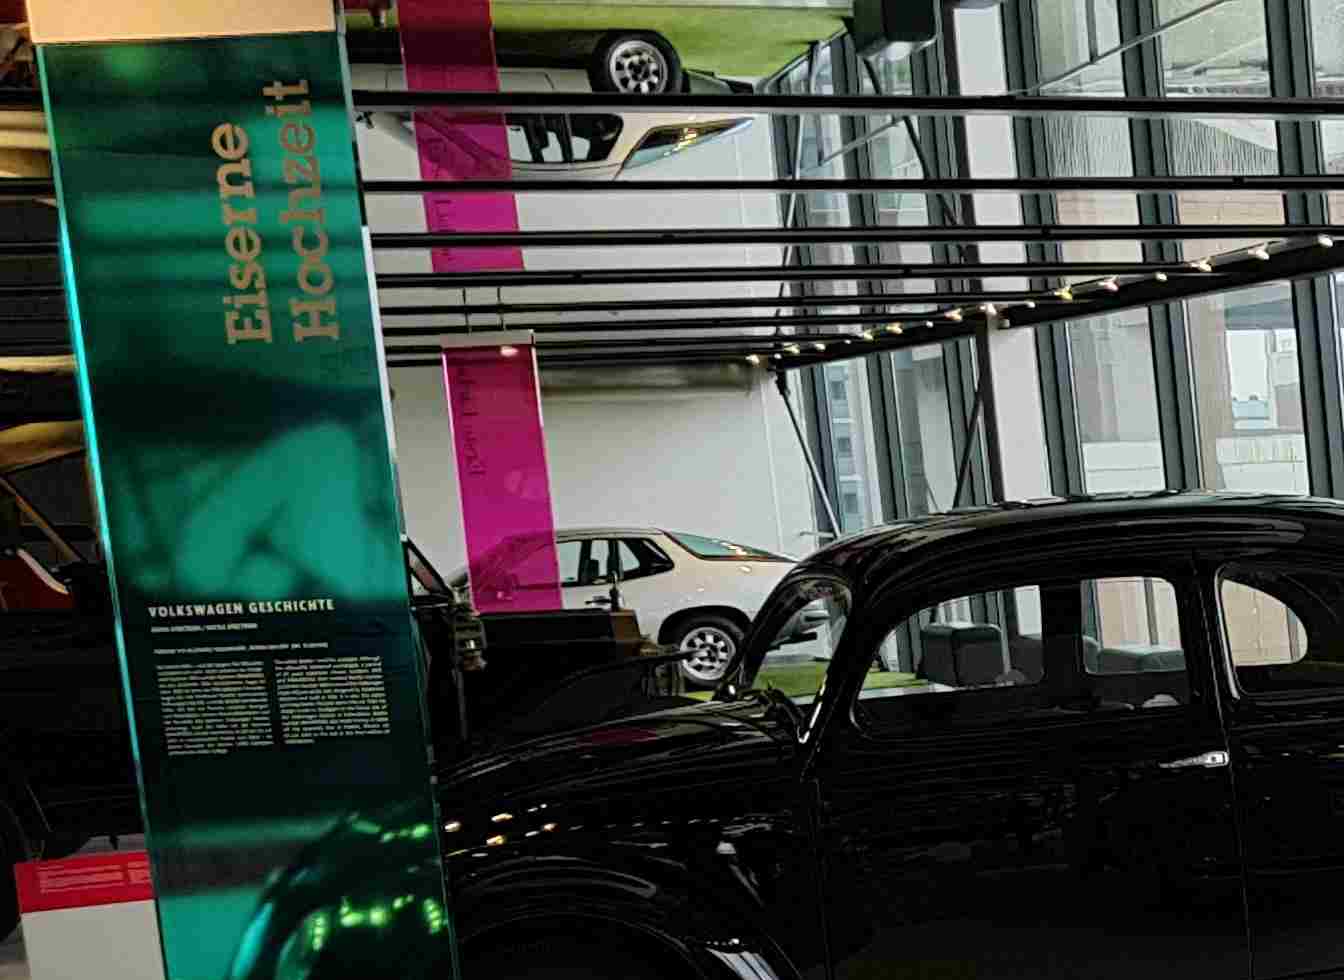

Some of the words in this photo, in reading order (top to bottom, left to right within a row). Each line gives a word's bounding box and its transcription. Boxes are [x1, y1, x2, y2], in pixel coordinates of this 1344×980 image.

[212, 122, 272, 344] Eiserne
[262, 79, 340, 343] Hochzeit
[148, 603, 243, 617] VOLKSWAGEN
[249, 599, 335, 613] GESCHICHTE
